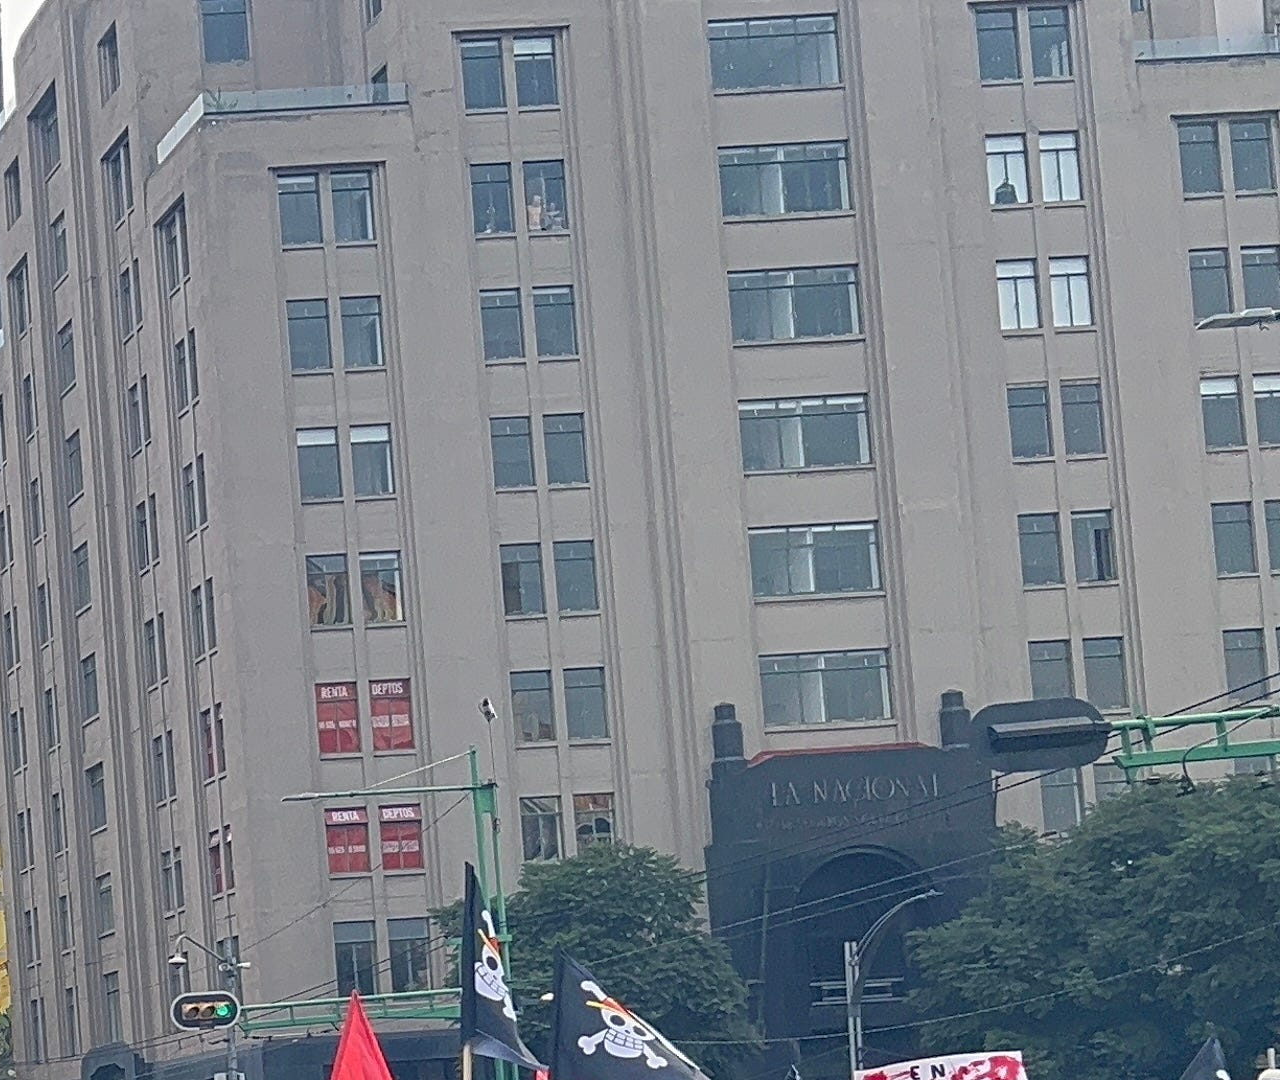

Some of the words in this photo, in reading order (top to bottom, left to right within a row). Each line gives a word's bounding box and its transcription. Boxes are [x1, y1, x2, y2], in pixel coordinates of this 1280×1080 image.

[321, 686, 348, 698] RENTA
[371, 682, 404, 695] DEPTOS
[771, 781, 801, 807] LA
[813, 773, 939, 803] NACIONAL
[331, 810, 360, 822] RENTA
[382, 807, 415, 819] DEPTOS
[910, 1063, 946, 1080] EN
